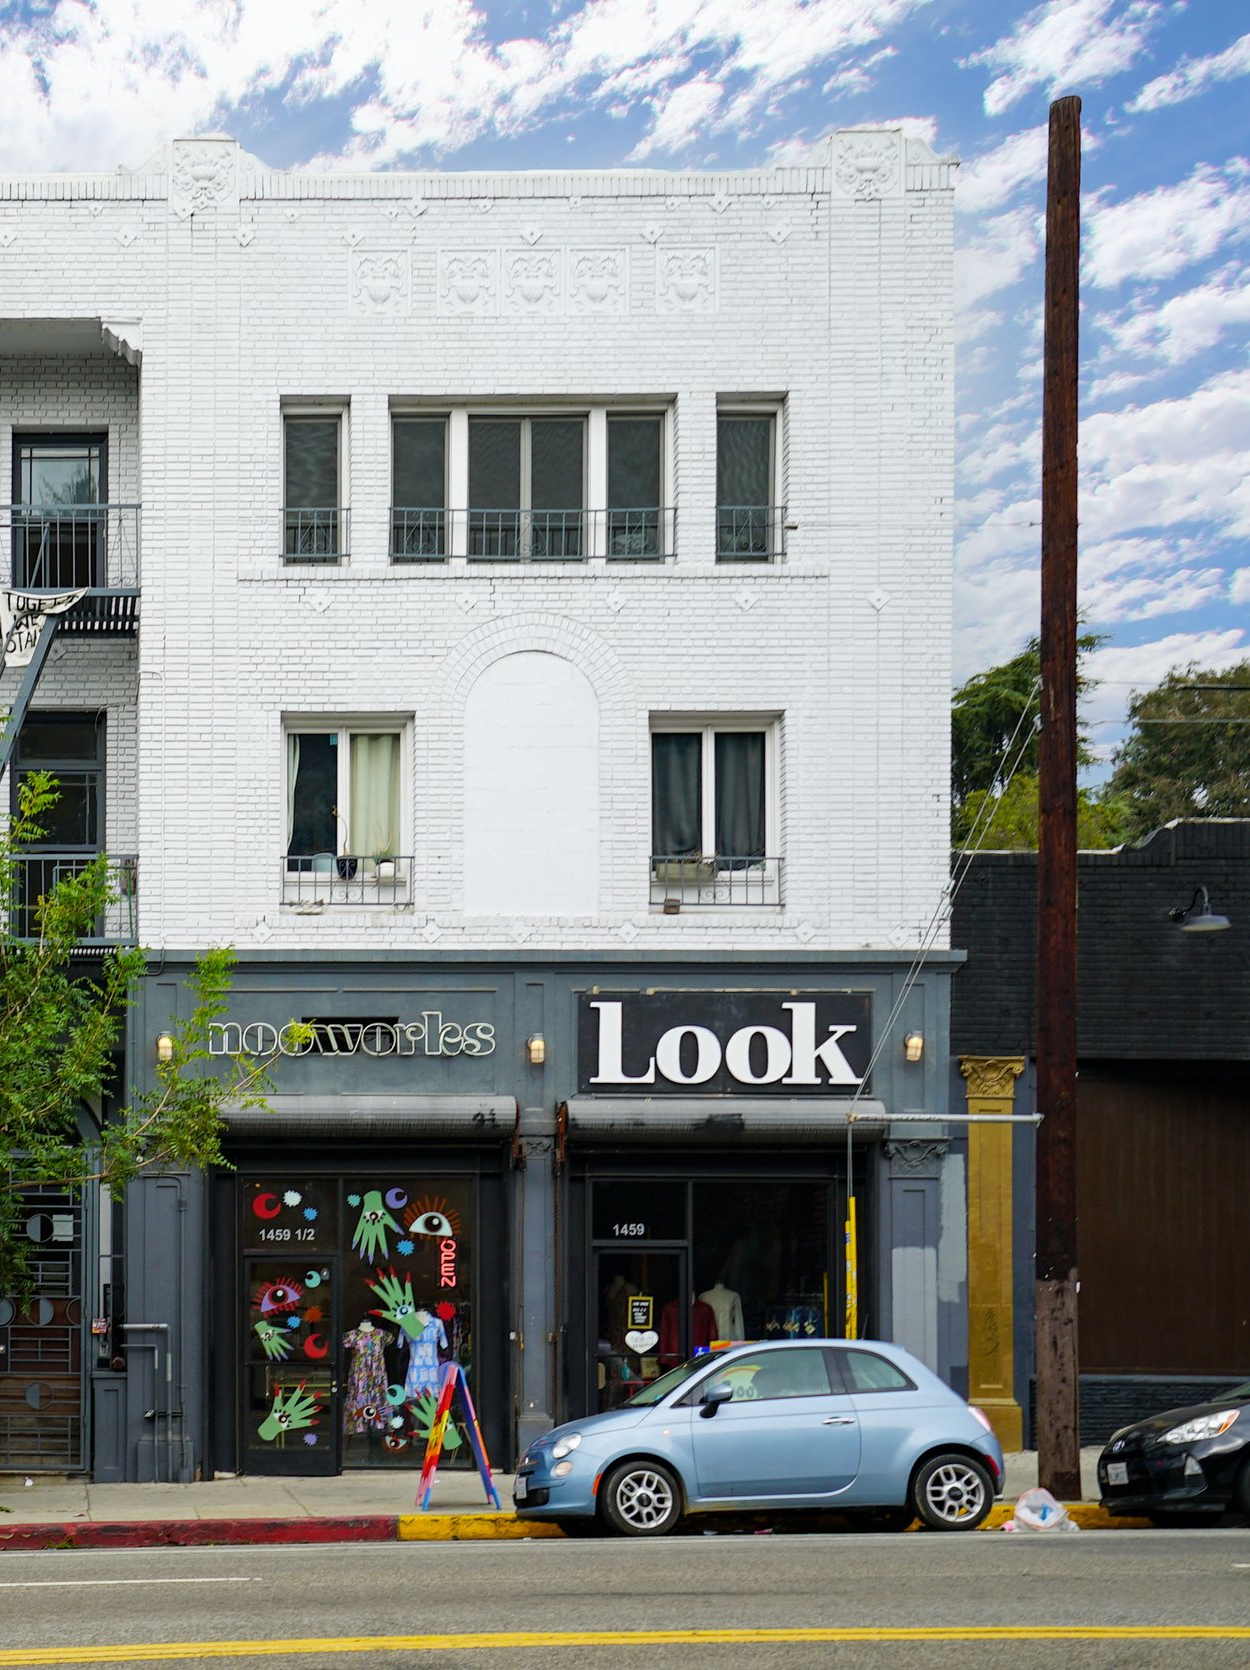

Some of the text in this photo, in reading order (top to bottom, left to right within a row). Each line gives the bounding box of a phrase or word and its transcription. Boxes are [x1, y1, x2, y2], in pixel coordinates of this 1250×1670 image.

[209, 1010, 497, 1057] nooworks
[589, 1001, 863, 1085] Look
[259, 1228, 316, 1241] 1459 1/2
[612, 1223, 645, 1237] 1459
[440, 1239, 457, 1288] OPEN
